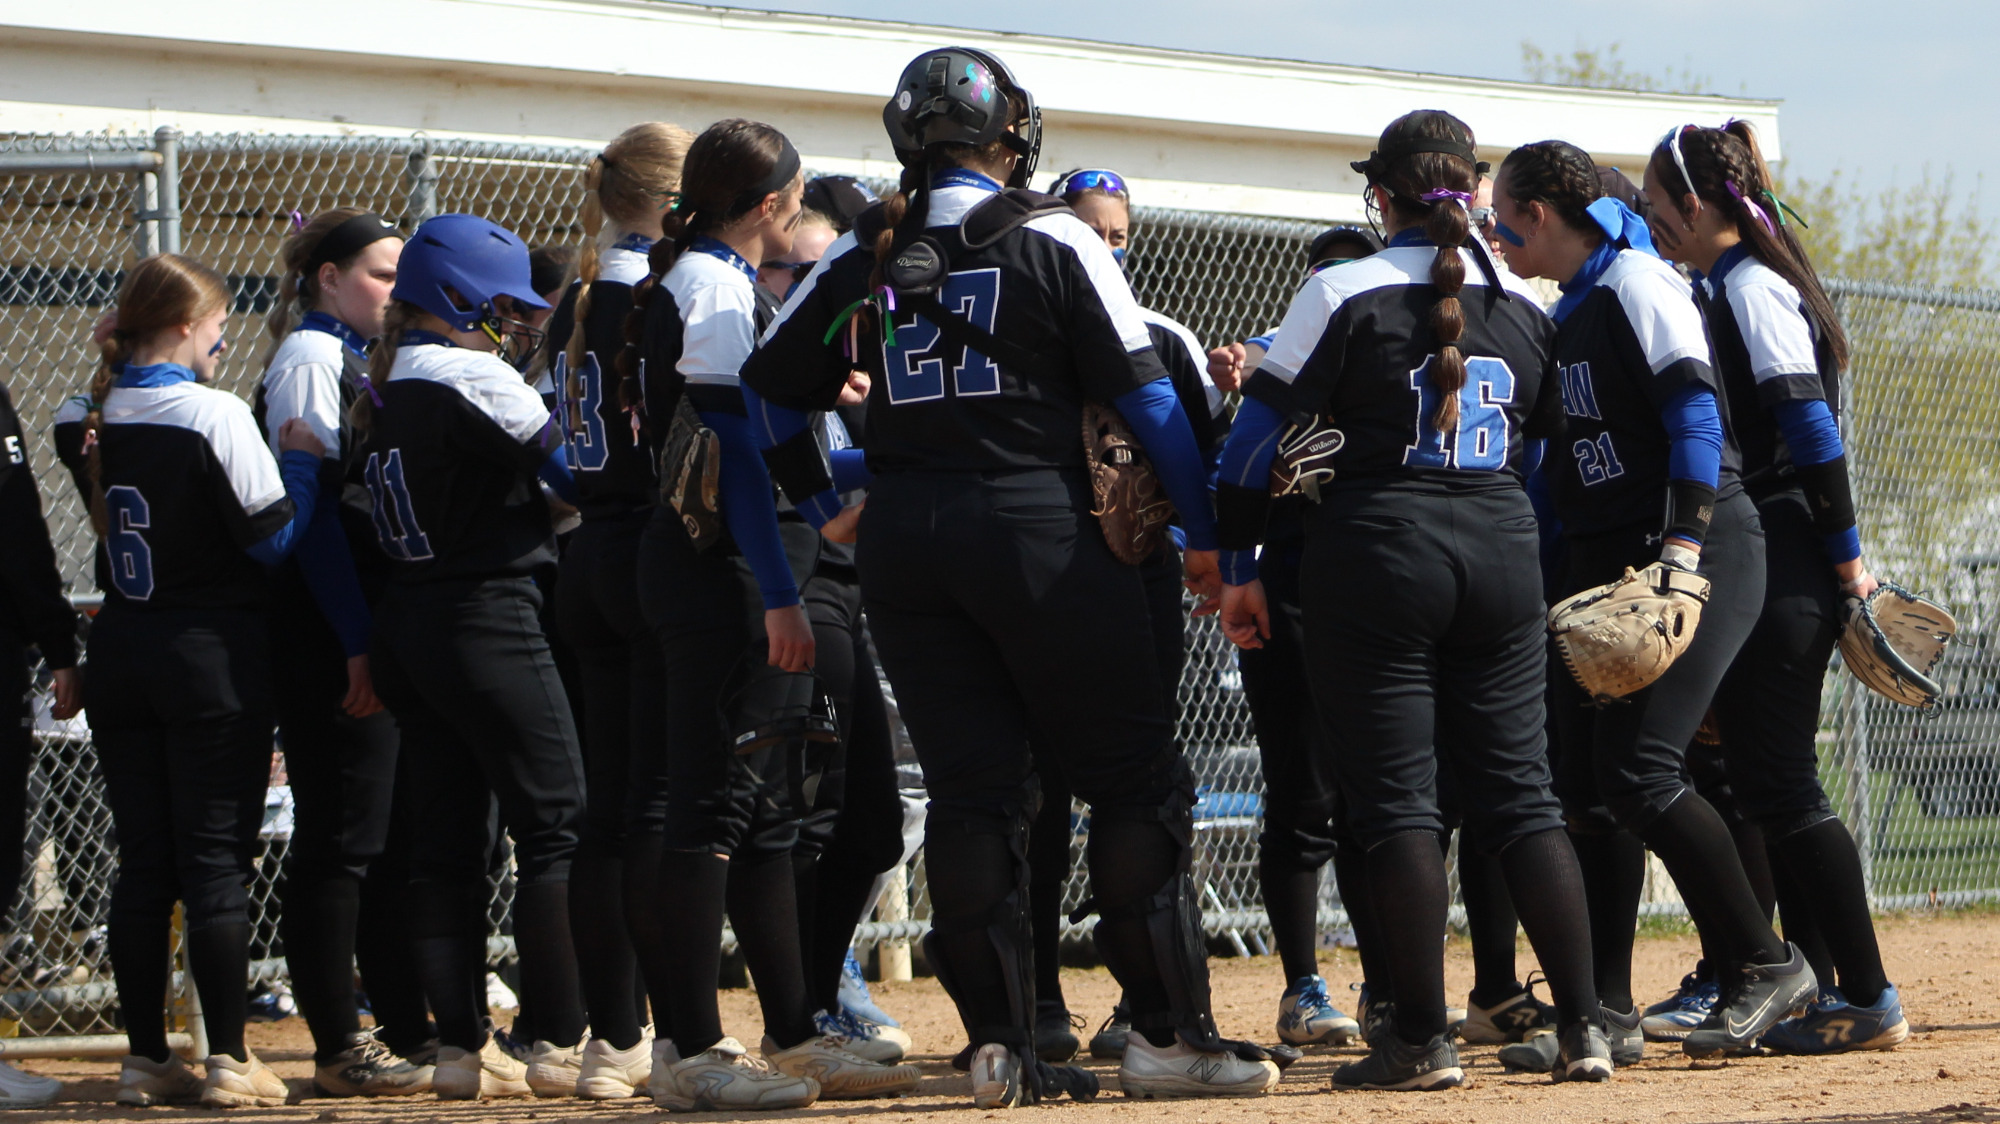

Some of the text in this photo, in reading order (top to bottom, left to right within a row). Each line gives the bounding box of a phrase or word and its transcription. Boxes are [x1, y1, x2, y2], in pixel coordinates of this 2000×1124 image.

[883, 267, 1001, 405] 27
[4, 435, 24, 464] 5
[554, 351, 609, 471] 13
[1307, 438, 1339, 453] Wilson
[1401, 353, 1515, 471] 16
[1572, 431, 1625, 487] 21
[104, 484, 155, 601] 6
[364, 447, 435, 561] 11
